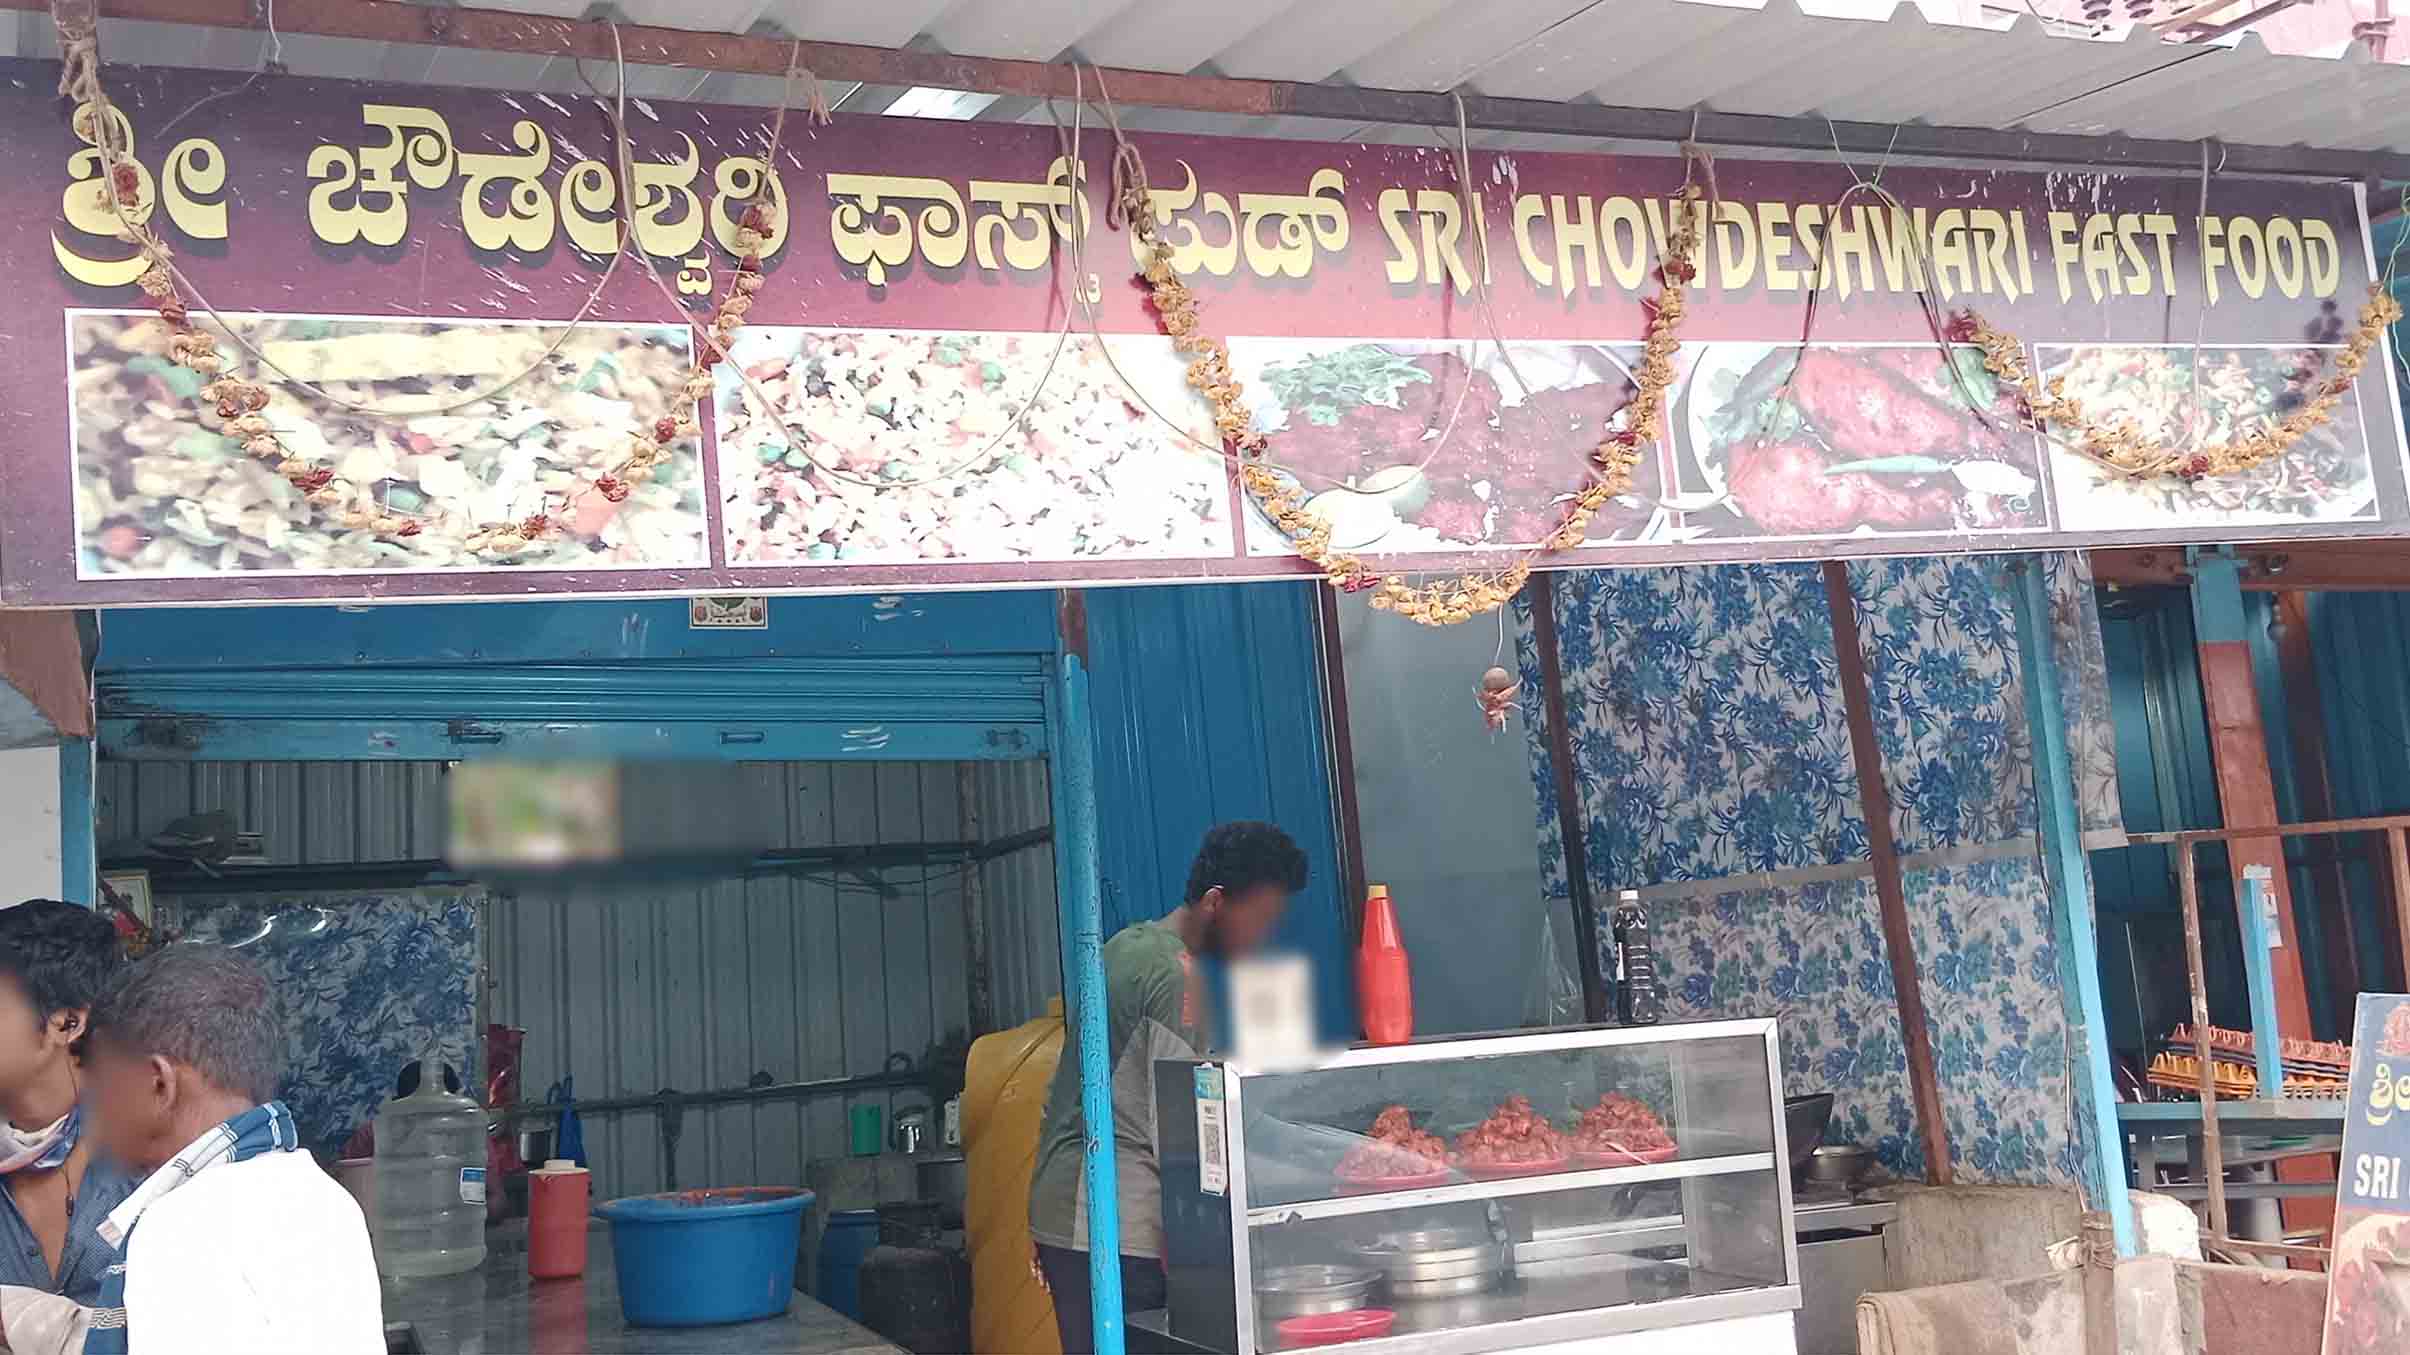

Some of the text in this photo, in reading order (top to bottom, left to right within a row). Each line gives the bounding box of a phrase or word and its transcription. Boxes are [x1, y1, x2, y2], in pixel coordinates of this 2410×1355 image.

[50, 101, 228, 287] ಶ್ರೀ
[1377, 188, 2341, 307] SRI CHOWDESHWARI FAST FOOD
[2354, 1153, 2401, 1199] SRI
